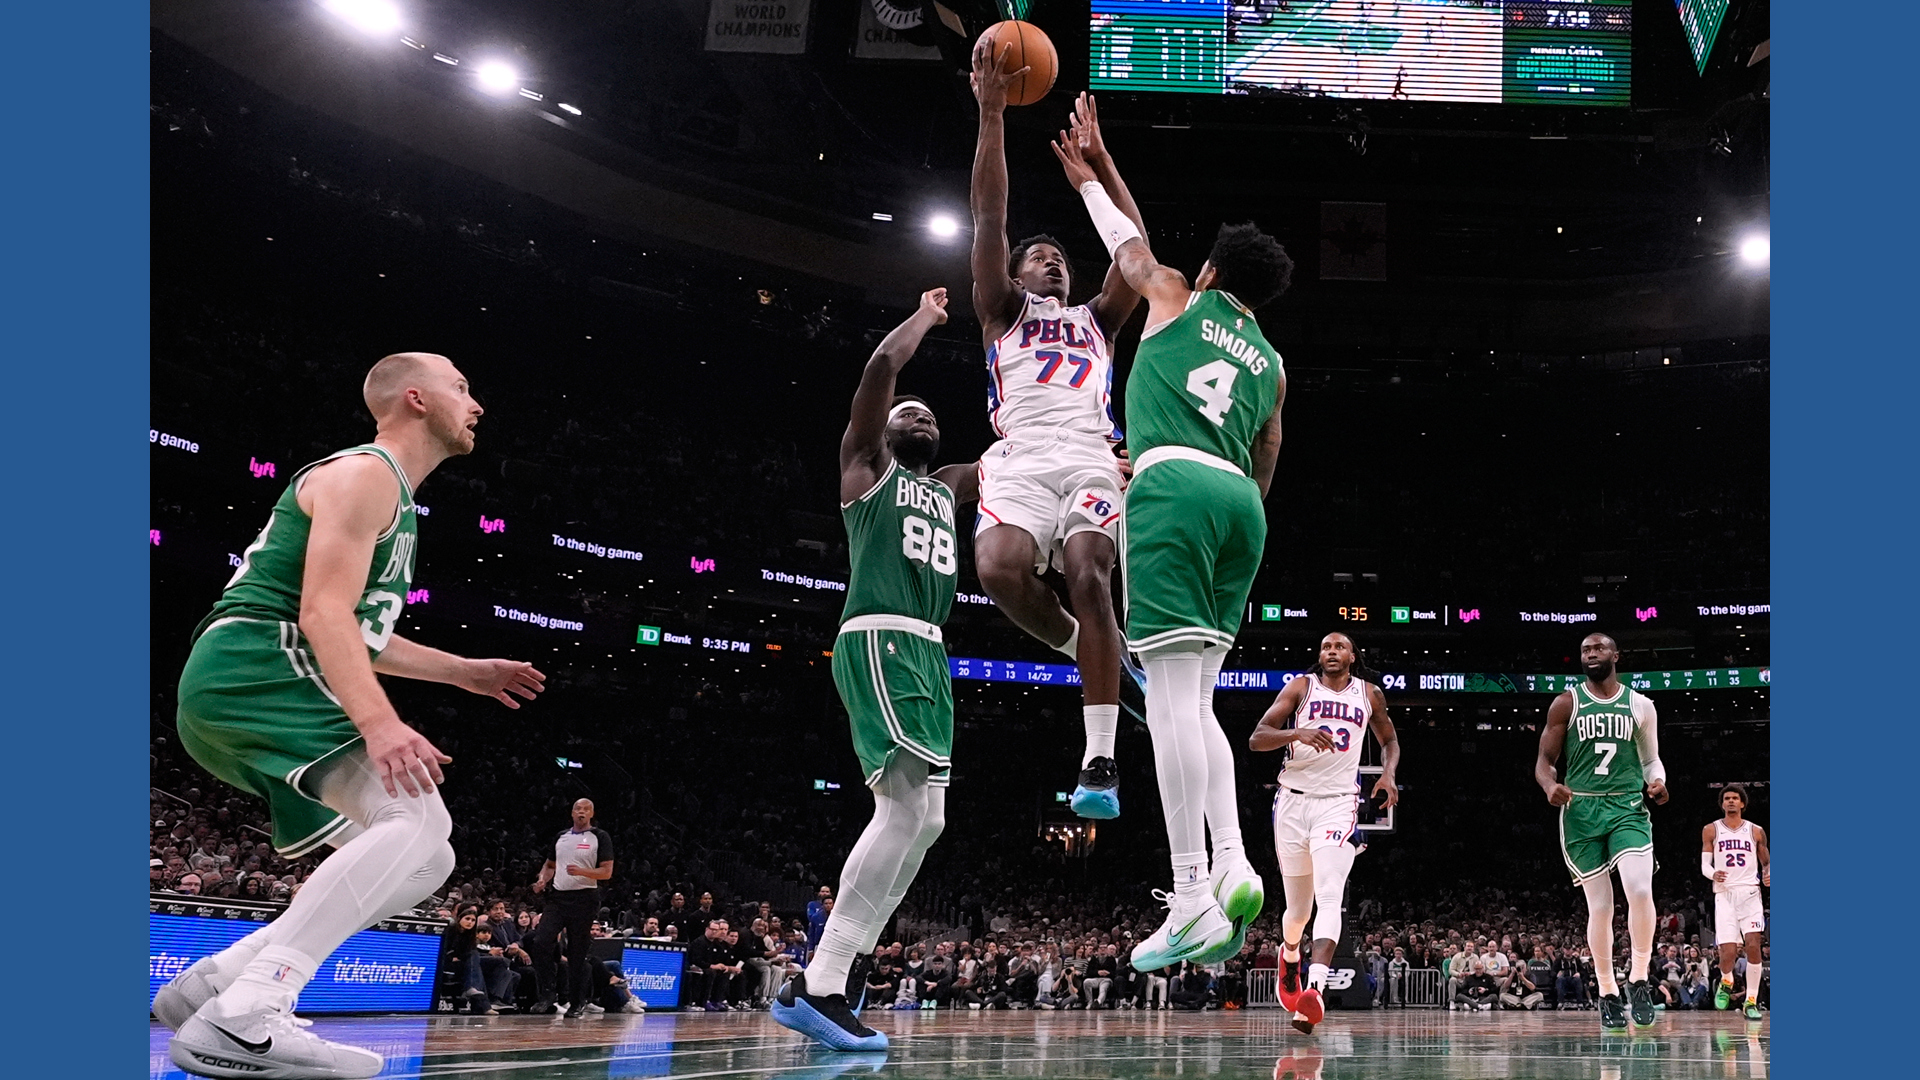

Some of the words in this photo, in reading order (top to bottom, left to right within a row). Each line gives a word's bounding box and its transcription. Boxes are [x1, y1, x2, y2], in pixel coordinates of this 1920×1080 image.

[735, 4, 786, 19] WORLD
[715, 21, 801, 37] CHAMPIONS
[1019, 318, 1101, 360] PHLA
[1201, 319, 1268, 376] SIMONS
[1035, 350, 1092, 388] 77
[1186, 359, 1239, 427] 4
[159, 433, 199, 453] game
[249, 457, 275, 478] lyft
[896, 476, 955, 531] BOSTON
[479, 515, 505, 533] lyft
[552, 534, 565, 546] To
[567, 538, 586, 551] the
[587, 542, 606, 557] big
[607, 547, 643, 561] game
[902, 514, 956, 576] 88
[228, 553, 242, 567] To
[690, 556, 715, 573] lyft
[761, 569, 774, 580] To
[775, 572, 795, 584] the
[796, 575, 814, 588] big
[815, 580, 846, 591] game
[407, 589, 429, 604] yft
[956, 592, 969, 603] To
[970, 594, 988, 604] the
[493, 605, 507, 618] To
[508, 609, 528, 622] the
[529, 612, 548, 627] big
[549, 618, 583, 631] game
[1264, 607, 1280, 618] TD
[1284, 608, 1308, 617] Bank
[1338, 607, 1367, 621] 9:35
[1393, 609, 1408, 620] TD
[1413, 610, 1436, 620] Bank
[1459, 608, 1480, 623] lyft
[1519, 611, 1531, 621] To
[1533, 612, 1549, 621] the
[1551, 612, 1567, 624] big
[1568, 613, 1597, 623] game
[1636, 606, 1657, 622] lyft
[1697, 606, 1710, 616] To
[1711, 605, 1729, 615] the
[1730, 604, 1746, 615] big
[1748, 605, 1770, 615] gam
[640, 628, 658, 642] TD
[664, 632, 691, 645] Bank
[702, 638, 729, 650] 9:35
[731, 642, 750, 653] PM
[958, 668, 970, 676] 20
[985, 669, 991, 678] 3
[1005, 670, 1016, 679] 13
[1028, 672, 1052, 682] 14/37
[1215, 672, 1268, 688] ADELPHIA
[1382, 675, 1406, 689] 94
[1419, 674, 1465, 690] BOSTON
[1529, 682, 1535, 691] 3
[1631, 680, 1650, 689] 9/38
[1664, 680, 1670, 688] 9
[1686, 679, 1692, 687] 7
[1708, 678, 1717, 686] 11
[1729, 677, 1740, 686] 35
[1308, 700, 1364, 729] PHILA
[1576, 713, 1634, 742] BOSTON
[1318, 725, 1351, 752] 3
[1594, 742, 1617, 775] 7
[1325, 830, 1342, 841] 76
[1718, 839, 1752, 852] PHILA
[1725, 853, 1746, 867] 25
[333, 957, 426, 984] ticketmaster
